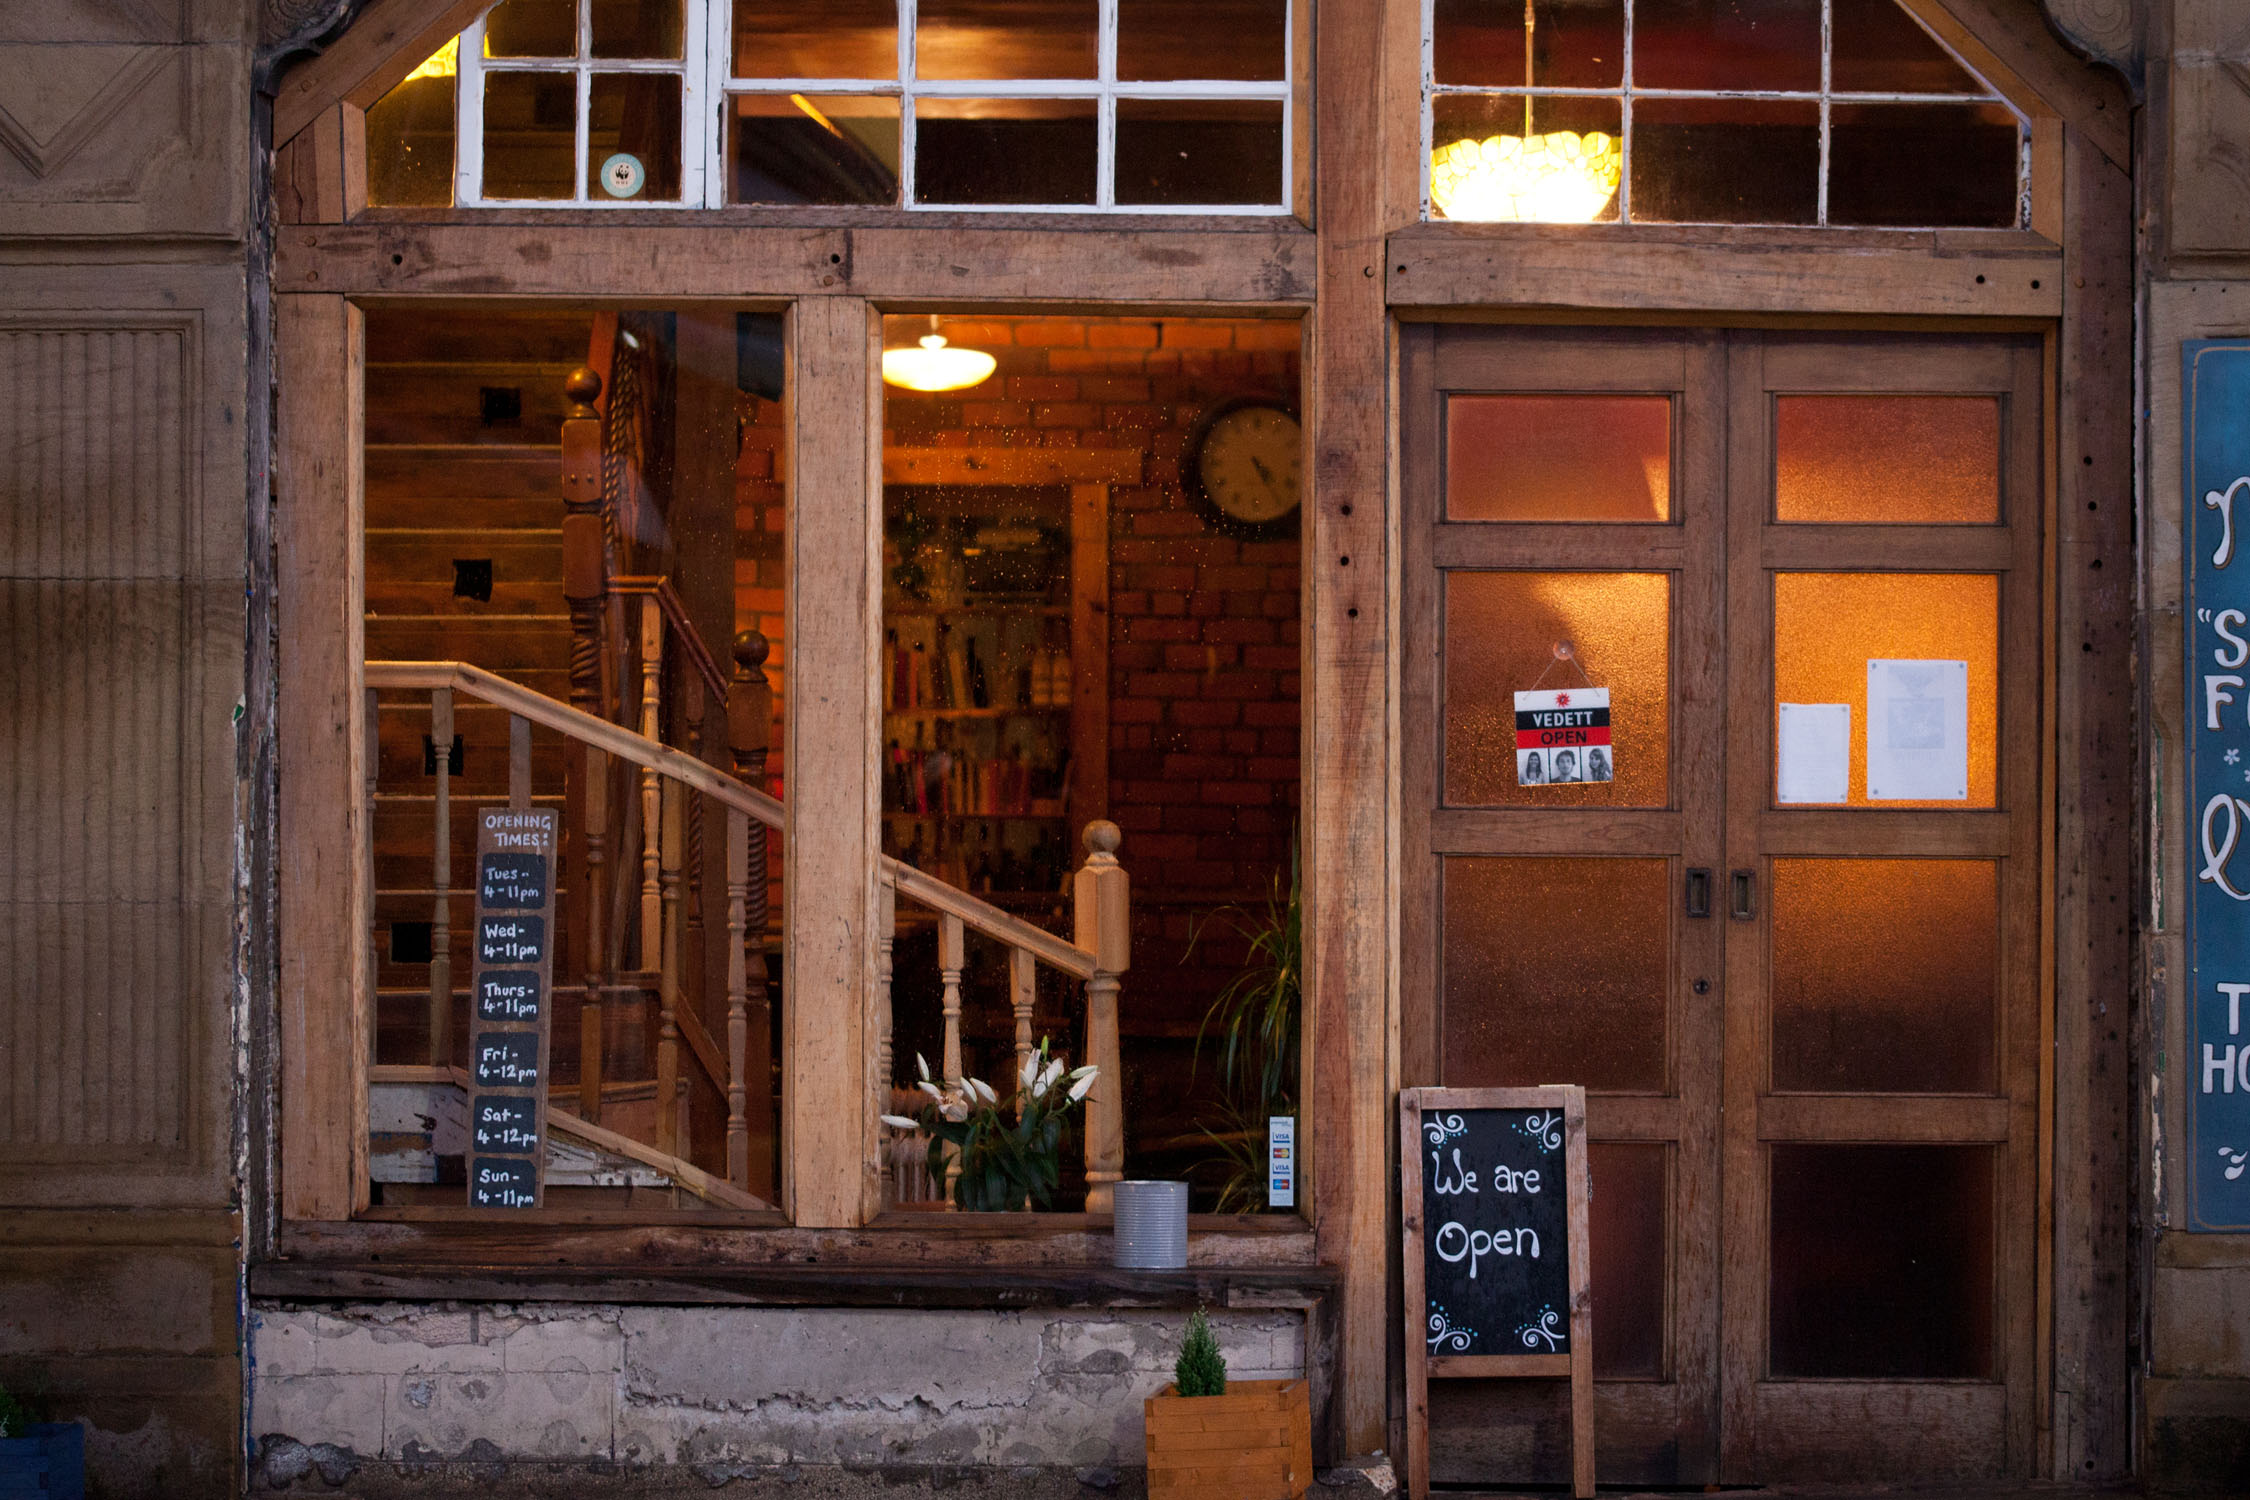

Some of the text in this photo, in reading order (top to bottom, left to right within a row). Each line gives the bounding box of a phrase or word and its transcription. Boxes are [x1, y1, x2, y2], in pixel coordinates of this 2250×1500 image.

[2204, 675, 2250, 729] F
[1533, 711, 1593, 728] VEDETT
[1541, 730, 1587, 745] OPEN
[485, 815, 551, 830] OPENING
[494, 832, 549, 847] TIMES:
[1432, 1148, 1541, 1195] We are
[1435, 1221, 1540, 1279] Open
